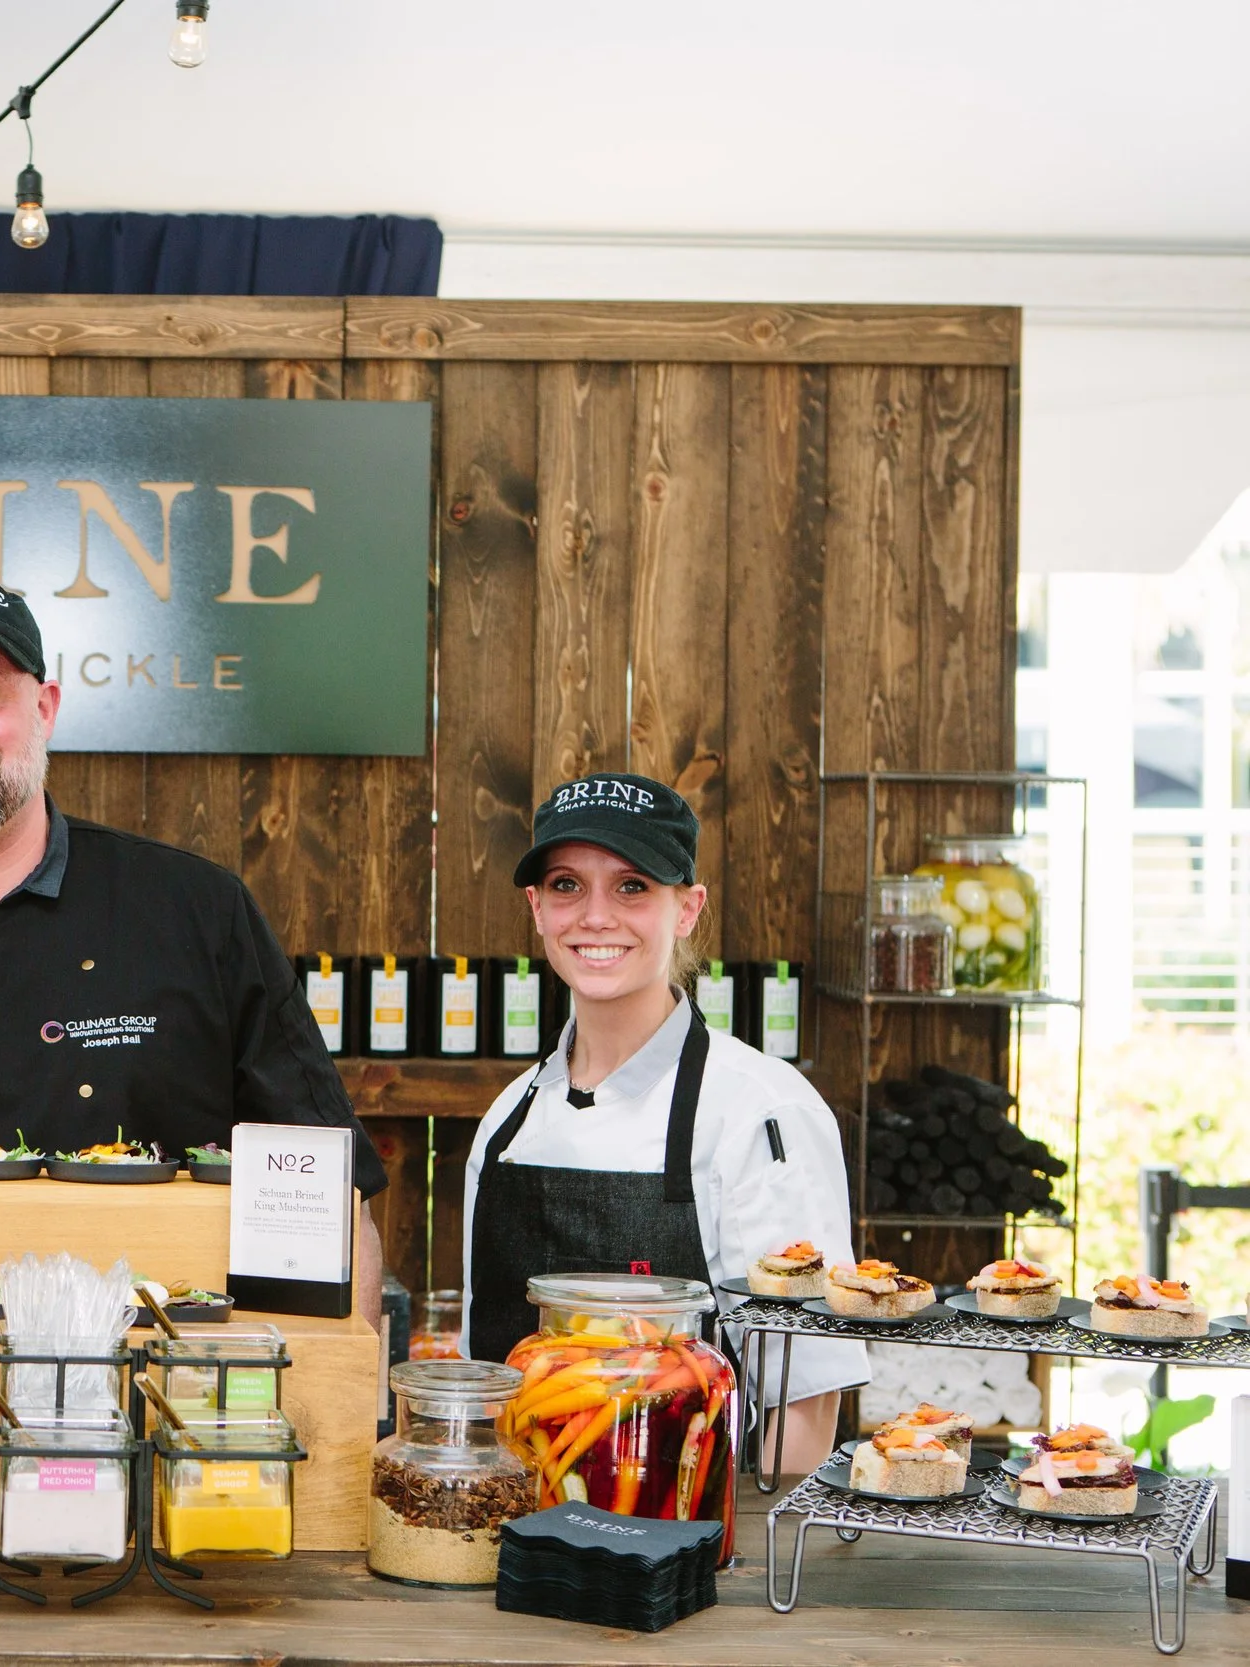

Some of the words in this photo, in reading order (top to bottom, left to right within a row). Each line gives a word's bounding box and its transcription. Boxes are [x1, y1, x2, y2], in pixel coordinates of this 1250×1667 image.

[56, 652, 244, 690] ICKLE
[554, 779, 655, 809] BRINE
[119, 1015, 157, 1027] GROUP
[82, 1035, 120, 1048] Joseph
[295, 1190, 324, 1201] Brined
[254, 1200, 276, 1212] King
[279, 1202, 330, 1214] Mushrooms
[43, 1477, 62, 1485] RED
[63, 1477, 92, 1485] ONION
